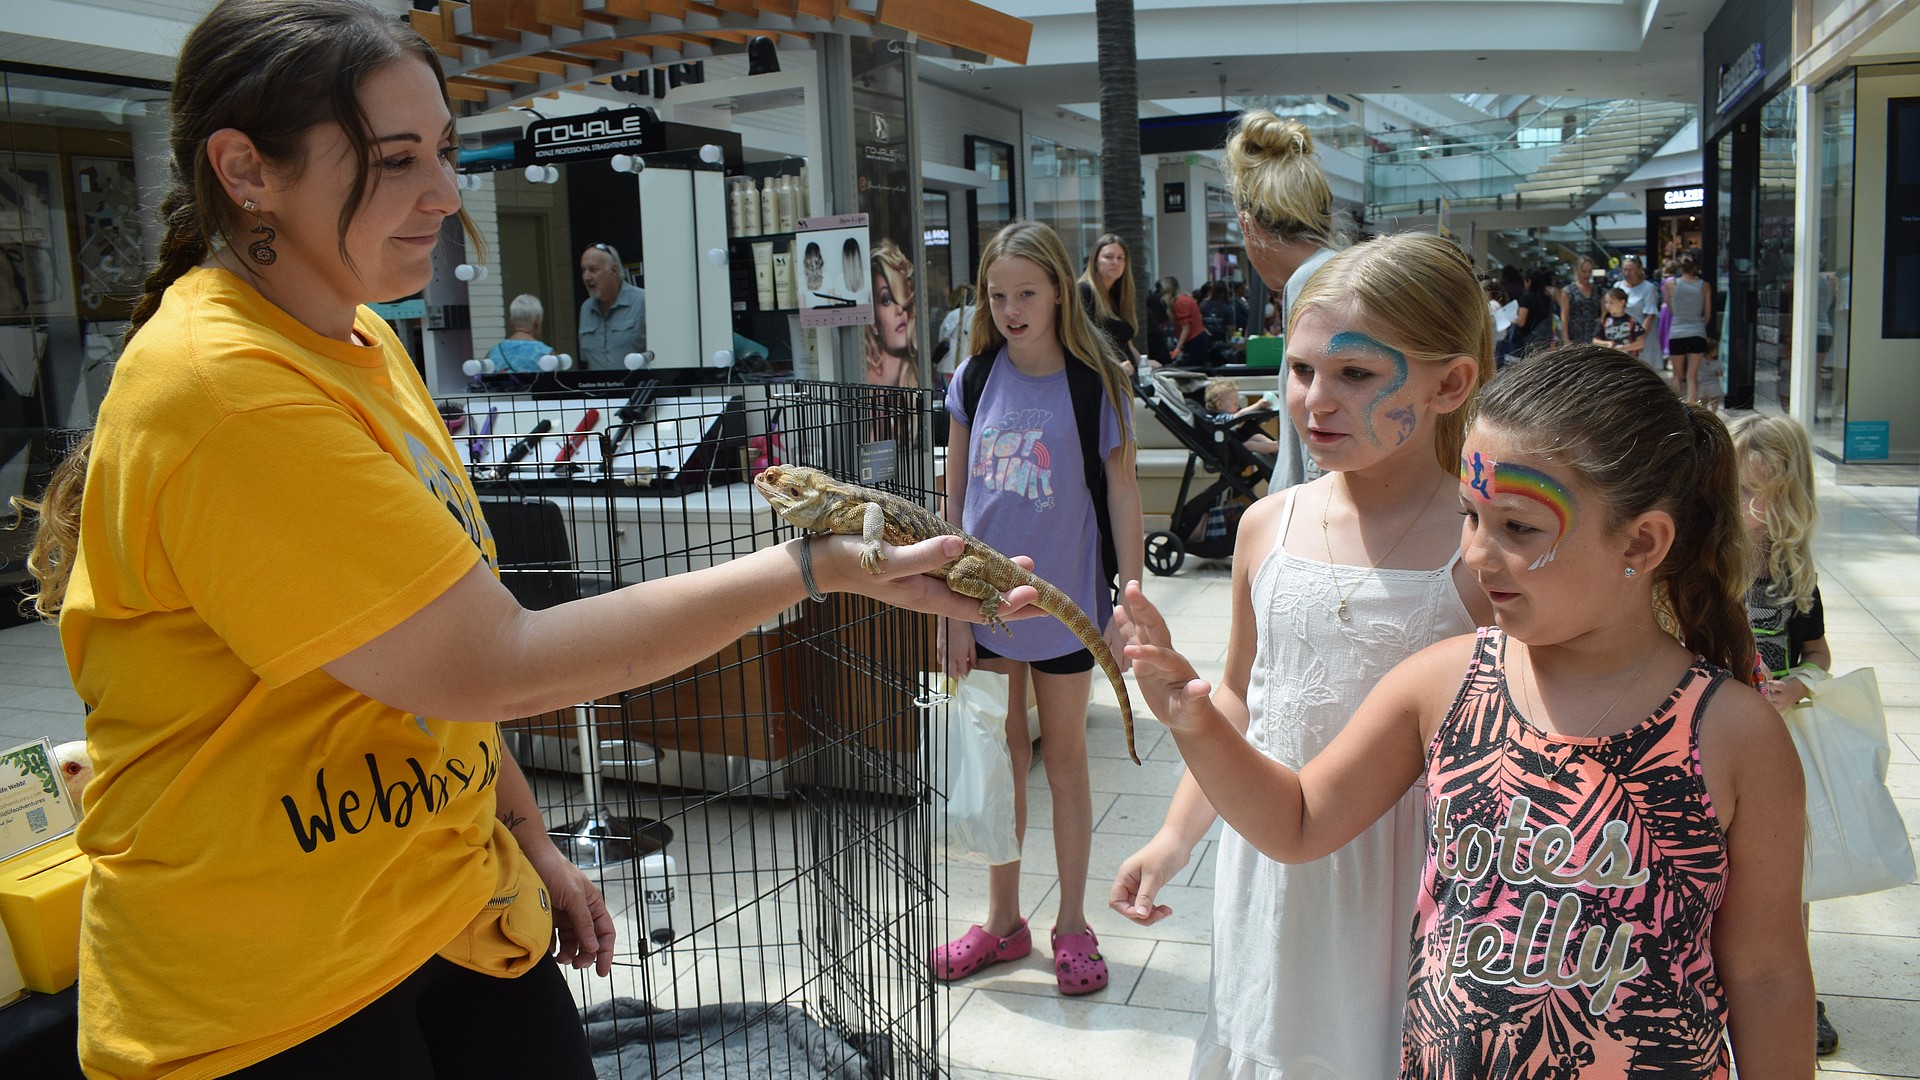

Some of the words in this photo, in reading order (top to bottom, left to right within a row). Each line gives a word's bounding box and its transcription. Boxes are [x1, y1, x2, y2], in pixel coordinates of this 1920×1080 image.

[555, 145, 591, 156] PROFESSIONAL
[591, 141, 629, 152] STRAIGHTENER
[1433, 796, 1650, 887] totes
[1438, 883, 1647, 1016] jelly
